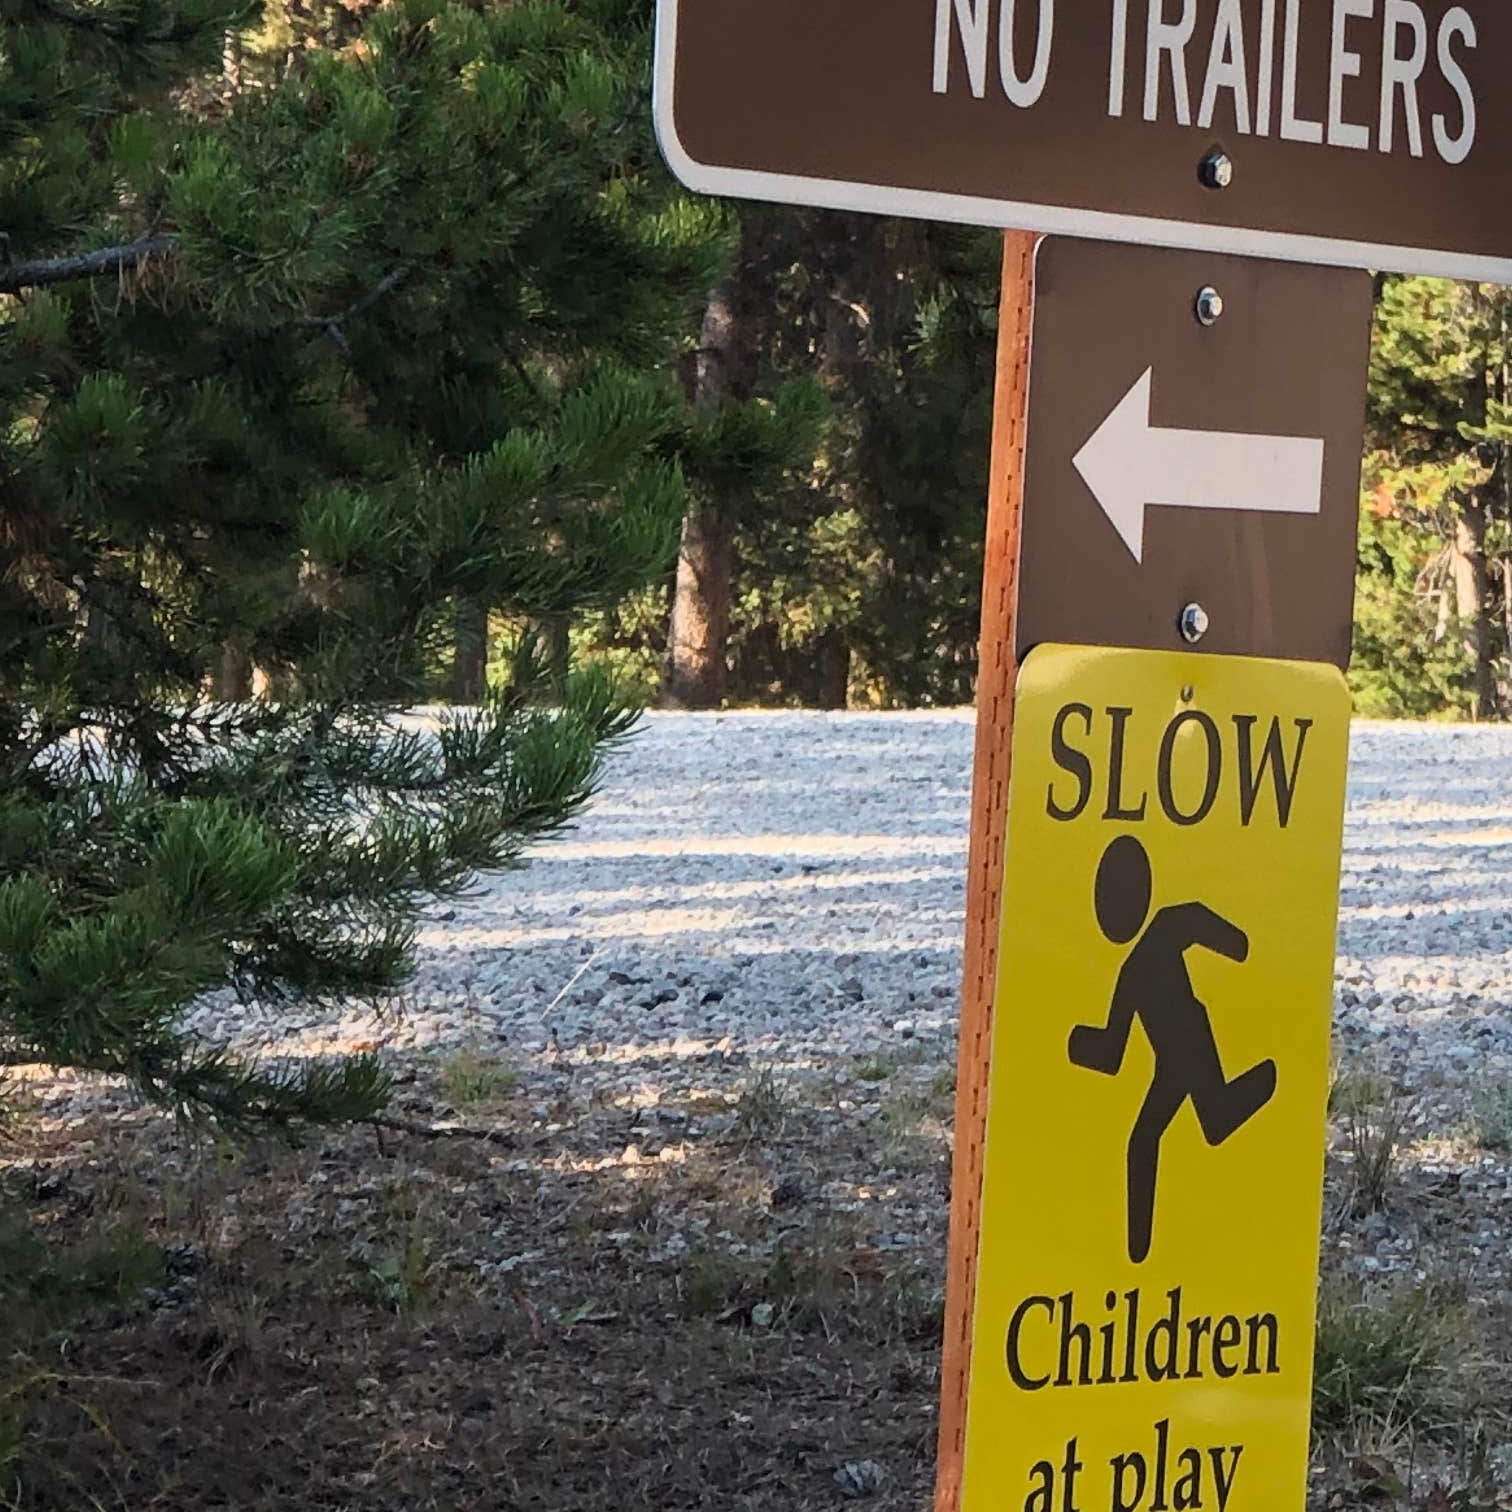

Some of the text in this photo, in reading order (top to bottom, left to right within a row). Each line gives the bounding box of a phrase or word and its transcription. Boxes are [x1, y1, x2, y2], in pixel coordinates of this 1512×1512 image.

[1045, 701, 1313, 829] SLOW
[1005, 1285, 1281, 1391] Children
[1024, 1418, 1244, 1512] at play
